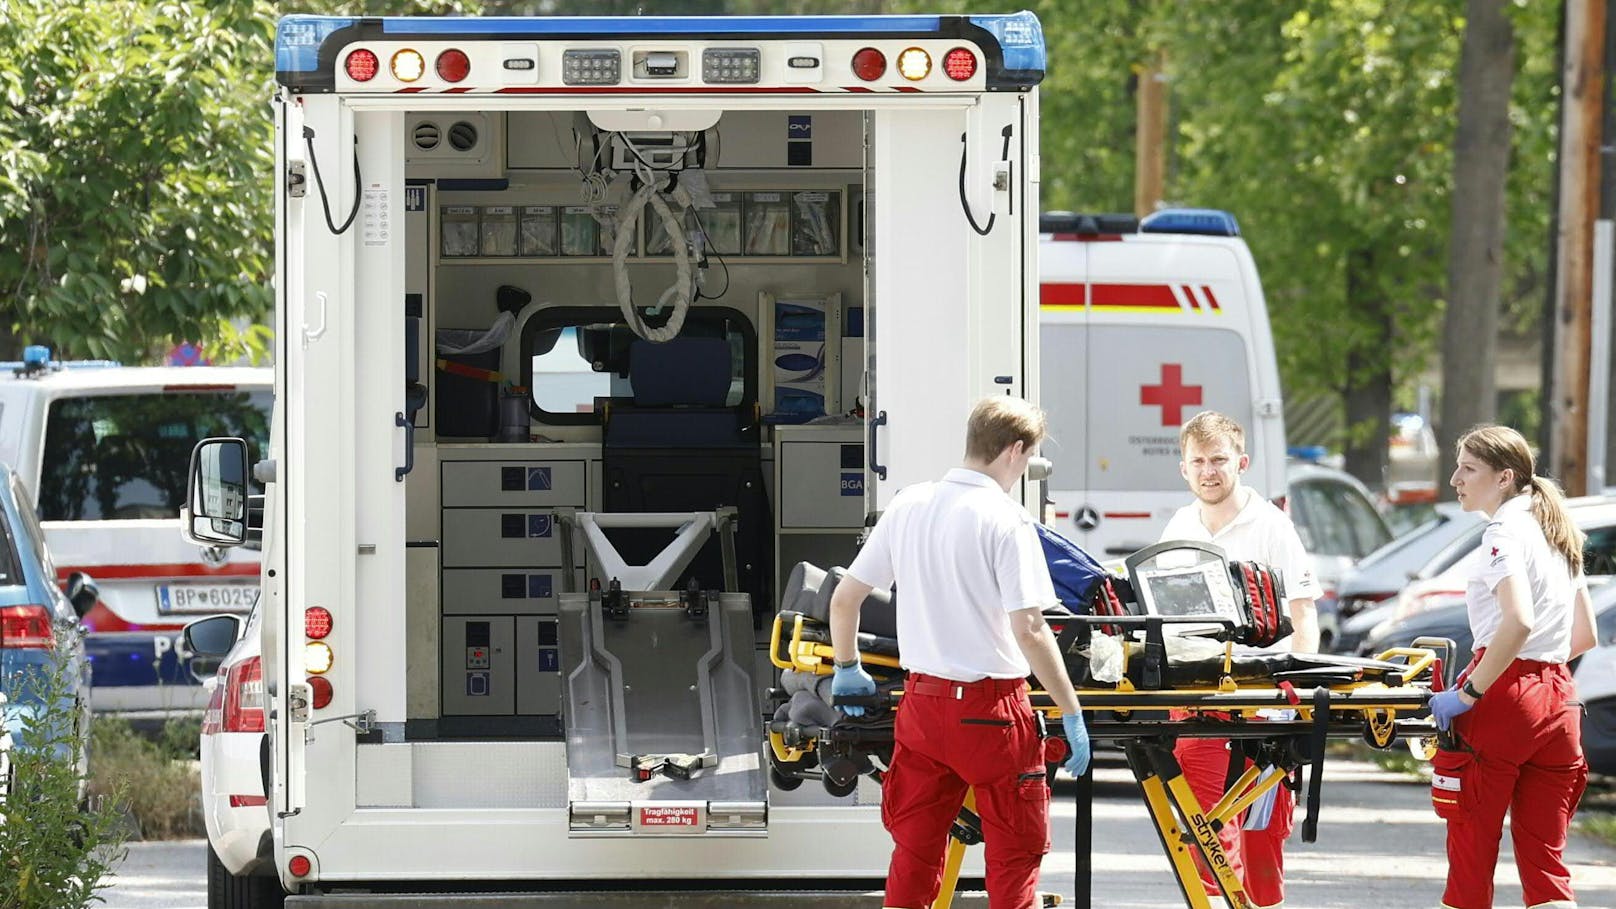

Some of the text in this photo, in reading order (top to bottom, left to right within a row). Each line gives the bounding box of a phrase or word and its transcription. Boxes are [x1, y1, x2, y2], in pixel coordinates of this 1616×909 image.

[841, 480, 863, 489] BGA
[175, 588, 196, 607] BP
[644, 808, 695, 816] Tragfähigkeit
[666, 816, 681, 824] 280
[682, 816, 692, 825] kg
[1190, 813, 1229, 869] stryker
